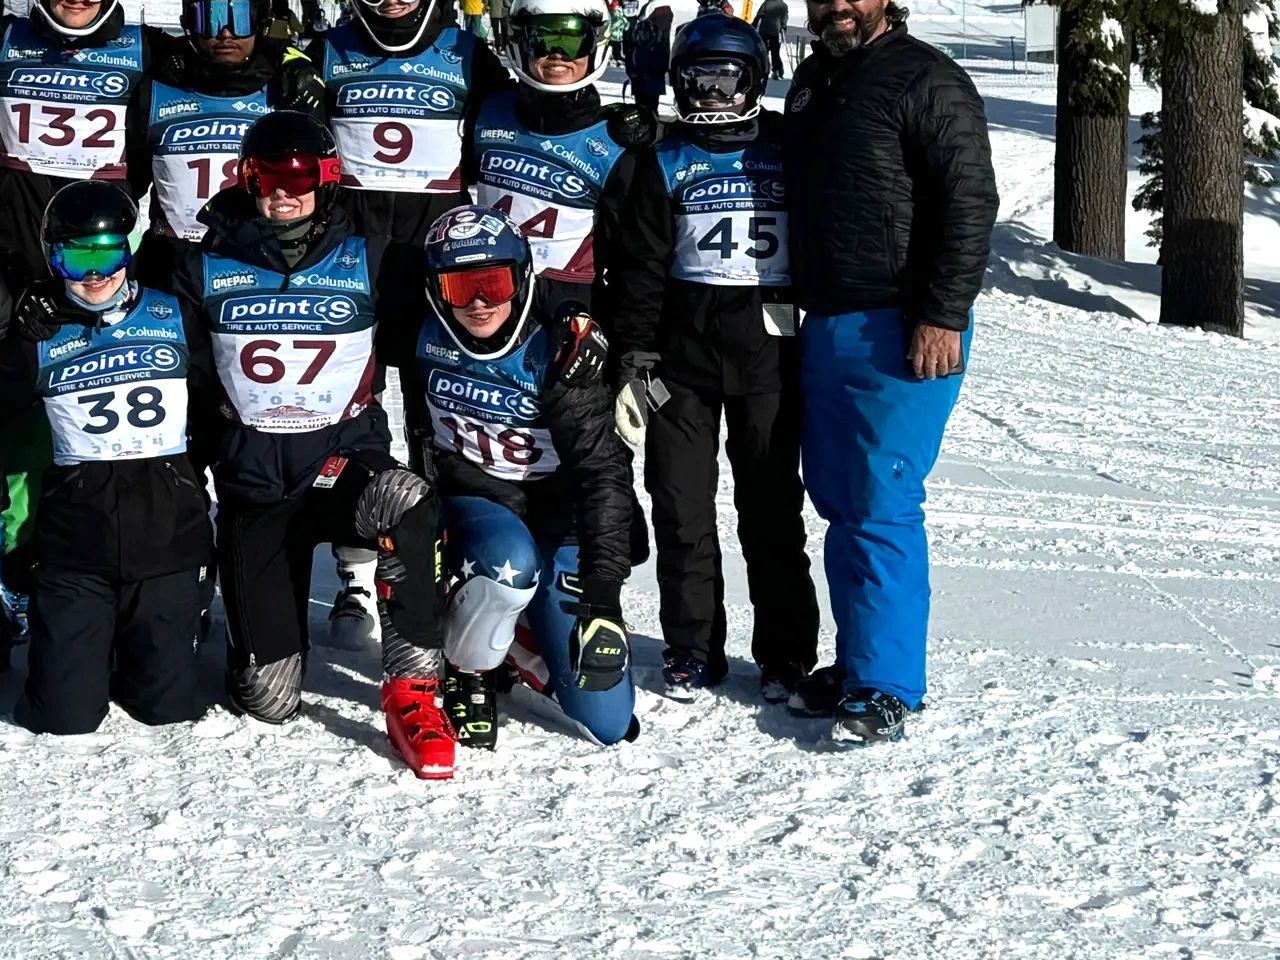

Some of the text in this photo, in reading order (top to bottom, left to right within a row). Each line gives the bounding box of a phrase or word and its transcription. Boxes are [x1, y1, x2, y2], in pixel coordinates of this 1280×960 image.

[88, 53, 137, 67] Columbia
[18, 72, 123, 92] point S
[414, 64, 464, 85] Columbia
[346, 84, 450, 106] point S
[390, 107, 424, 115] SERVICE
[11, 103, 117, 148] 132
[172, 122, 250, 141] point
[373, 121, 413, 164] 9
[552, 144, 600, 180] Columbia
[488, 155, 584, 193] point S
[502, 178, 519, 189] AUTO
[521, 184, 554, 198] SERVICE
[690, 180, 756, 200] point
[711, 202, 733, 210] AUTO
[697, 217, 779, 260] 45
[307, 274, 364, 289] Columbia
[231, 299, 351, 319] point S
[126, 327, 177, 339] Columbia
[60, 349, 174, 380] point S
[240, 340, 336, 385] 67
[88, 377, 111, 386] AUTO
[114, 371, 151, 381] SERVICE
[436, 378, 502, 405] point
[78, 386, 166, 434] 38
[595, 647, 621, 655] LEKI
